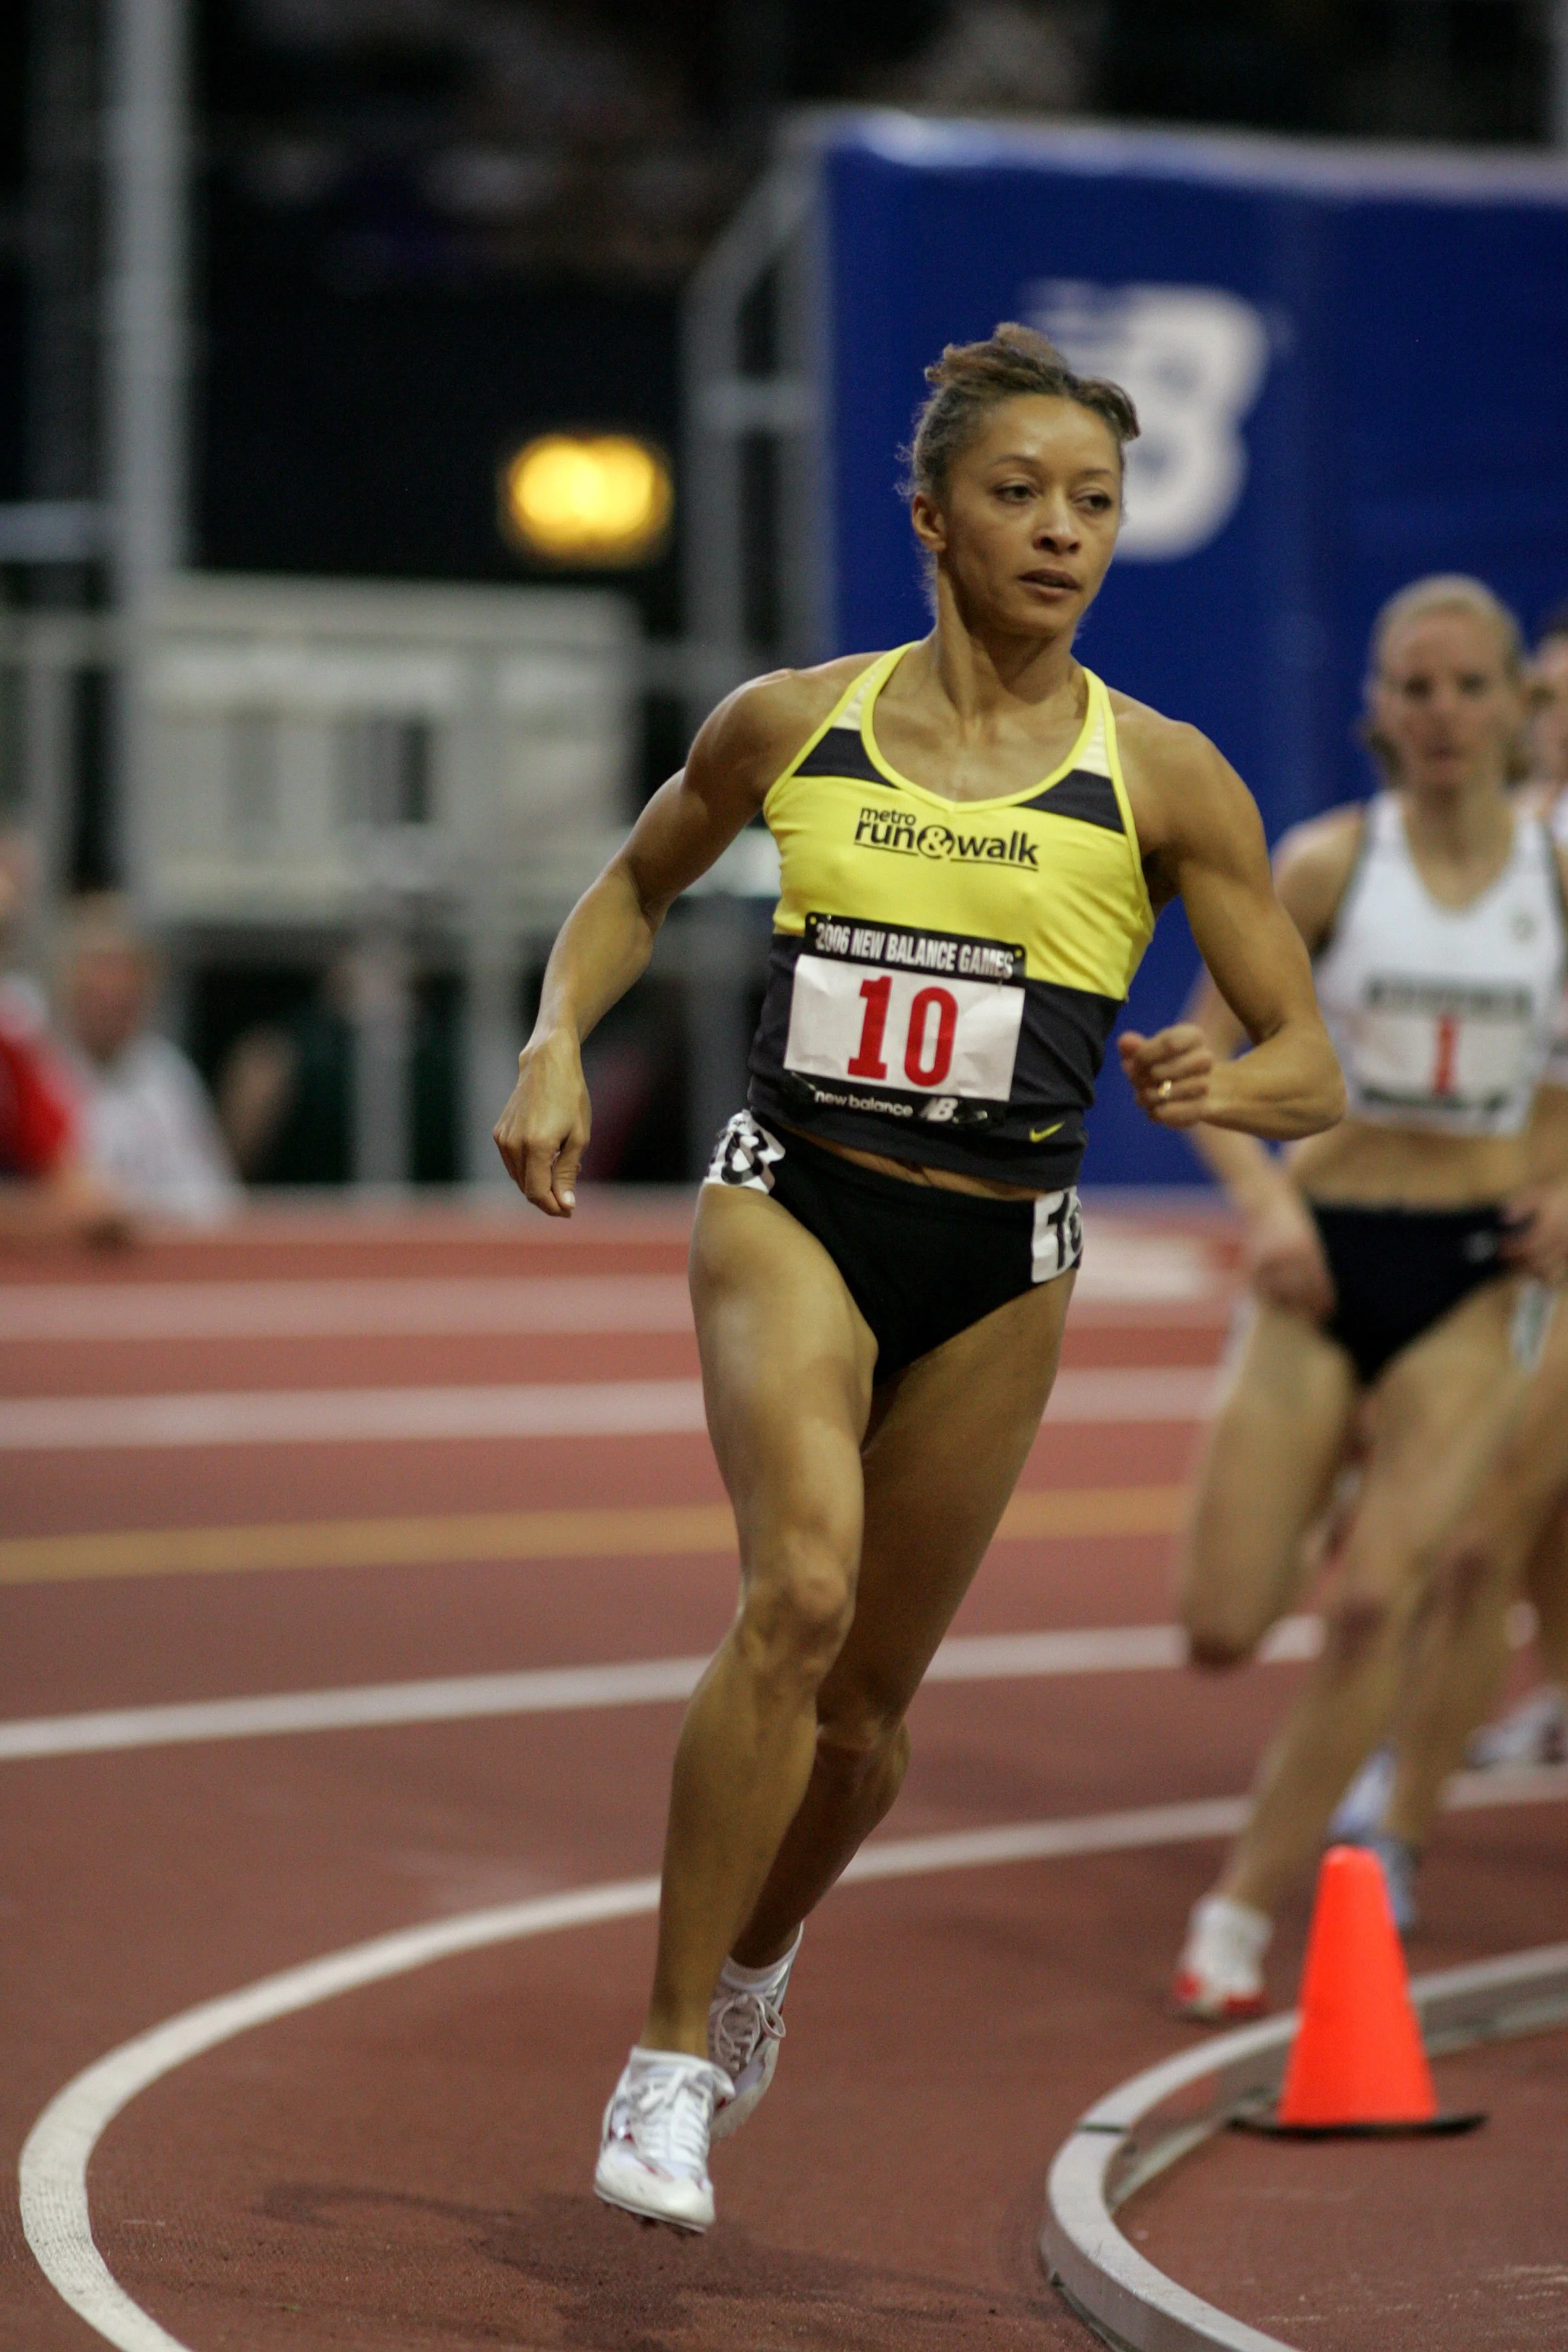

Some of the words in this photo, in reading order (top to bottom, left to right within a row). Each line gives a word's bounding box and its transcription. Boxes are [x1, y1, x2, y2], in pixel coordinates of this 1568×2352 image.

[860, 807, 917, 826] metro
[816, 923, 851, 955] 2006
[851, 927, 885, 960] NEW
[885, 932, 958, 972] BALANCE
[958, 944, 1014, 979] GAMES
[847, 974, 958, 1087] 10
[814, 1090, 848, 1106] new
[849, 1094, 914, 1118] balance
